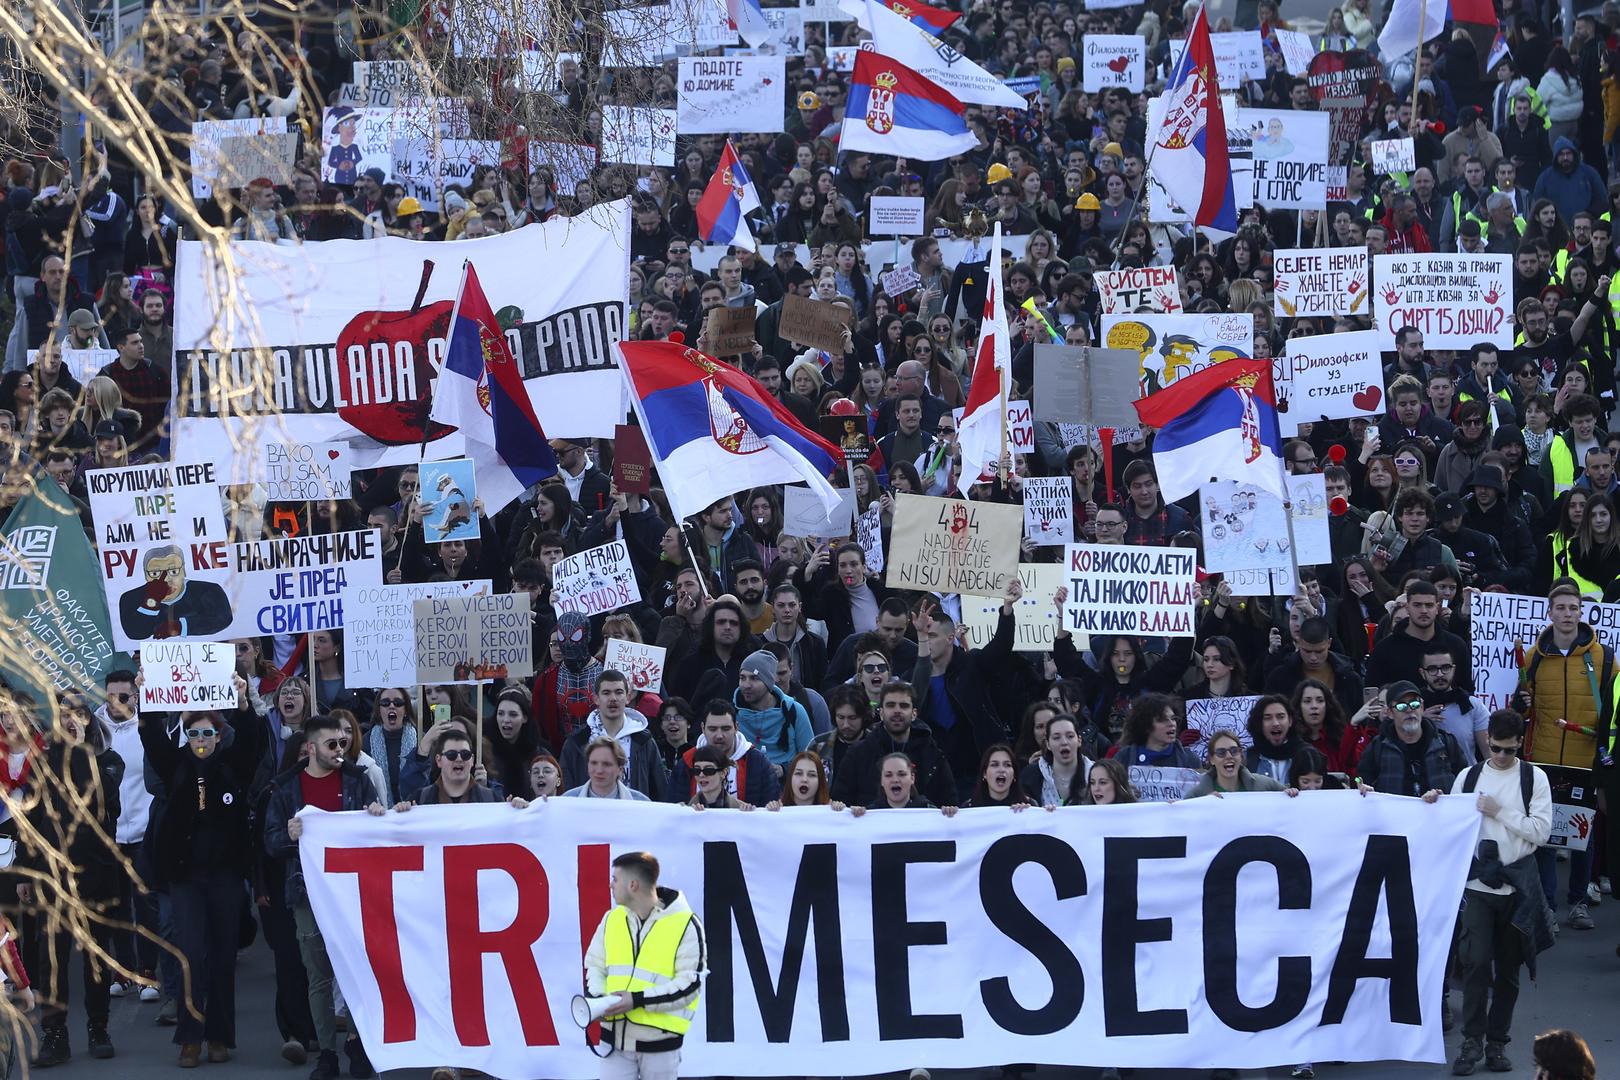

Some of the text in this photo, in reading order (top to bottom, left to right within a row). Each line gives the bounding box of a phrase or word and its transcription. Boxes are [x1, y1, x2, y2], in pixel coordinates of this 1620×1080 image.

[693, 61, 743, 77] ПАДАТЕ
[683, 79, 735, 92] КО ДОМИНЕ
[1274, 161, 1326, 182] ДОПИРЕ
[1267, 180, 1303, 201] ГЛАС
[1275, 253, 1367, 274] СЕЈЕТЕ НЕМАР
[1392, 262, 1408, 274] АКО
[1428, 260, 1454, 273] КАЗНА
[1458, 260, 1467, 273] ЗА
[1470, 260, 1503, 273] ГРАФИТ
[1108, 267, 1175, 290] СИСТЕМ
[1298, 272, 1344, 293] ЖАЊЕТЕ
[1116, 288, 1152, 308] ТЕ
[1295, 292, 1348, 314] ГУБИТКЕ
[1405, 290, 1424, 304] ШТА
[1437, 289, 1463, 302] КАЗНА
[1468, 289, 1479, 302] ЗА
[1389, 306, 1435, 335] СМРТ
[1453, 306, 1505, 336] ЉУДИ?
[303, 340, 420, 410] VLADA
[535, 303, 622, 373] PADA
[1294, 352, 1369, 374] Филозофски
[267, 445, 313, 463] BAKO
[89, 462, 216, 494] КОРУПЦИЈА ПЕРЕ
[267, 464, 331, 482] TU SAM
[267, 480, 351, 500] DOBRO SAM
[1024, 486, 1071, 499] КУПИМ
[134, 493, 176, 516] ПАРЕ
[1029, 507, 1067, 521] УЧИМ
[106, 517, 207, 543] АЛИ НЕ И
[104, 541, 229, 578] РУ КЕ
[236, 530, 375, 572] НАЈМРАЧНИЈЕ
[584, 543, 625, 571] AFRAID
[917, 549, 991, 569] INSTITUCIJE
[1071, 549, 1193, 575] КО ВИСОКО ЛЕТИ
[269, 567, 348, 601] ЈЕ ПРЕД
[900, 564, 940, 587] NISU
[579, 586, 618, 615] SHOULD
[1070, 578, 1193, 606] ТАЈ НИСКО ПАДА
[377, 604, 414, 618] FRIEN
[433, 599, 451, 615] DA
[416, 612, 529, 633] KEROVI KEROVI
[1068, 608, 1191, 633] ЧАК ИАКО ВЛАДА
[23, 608, 96, 692] УМЕТНОСТИ
[417, 630, 529, 651] KEROVI KEROVI
[202, 643, 217, 662] SE
[418, 647, 528, 668] KEROVI KEROVI
[145, 685, 188, 704] MIRNOG
[324, 833, 1422, 1046] TRI MESECA
